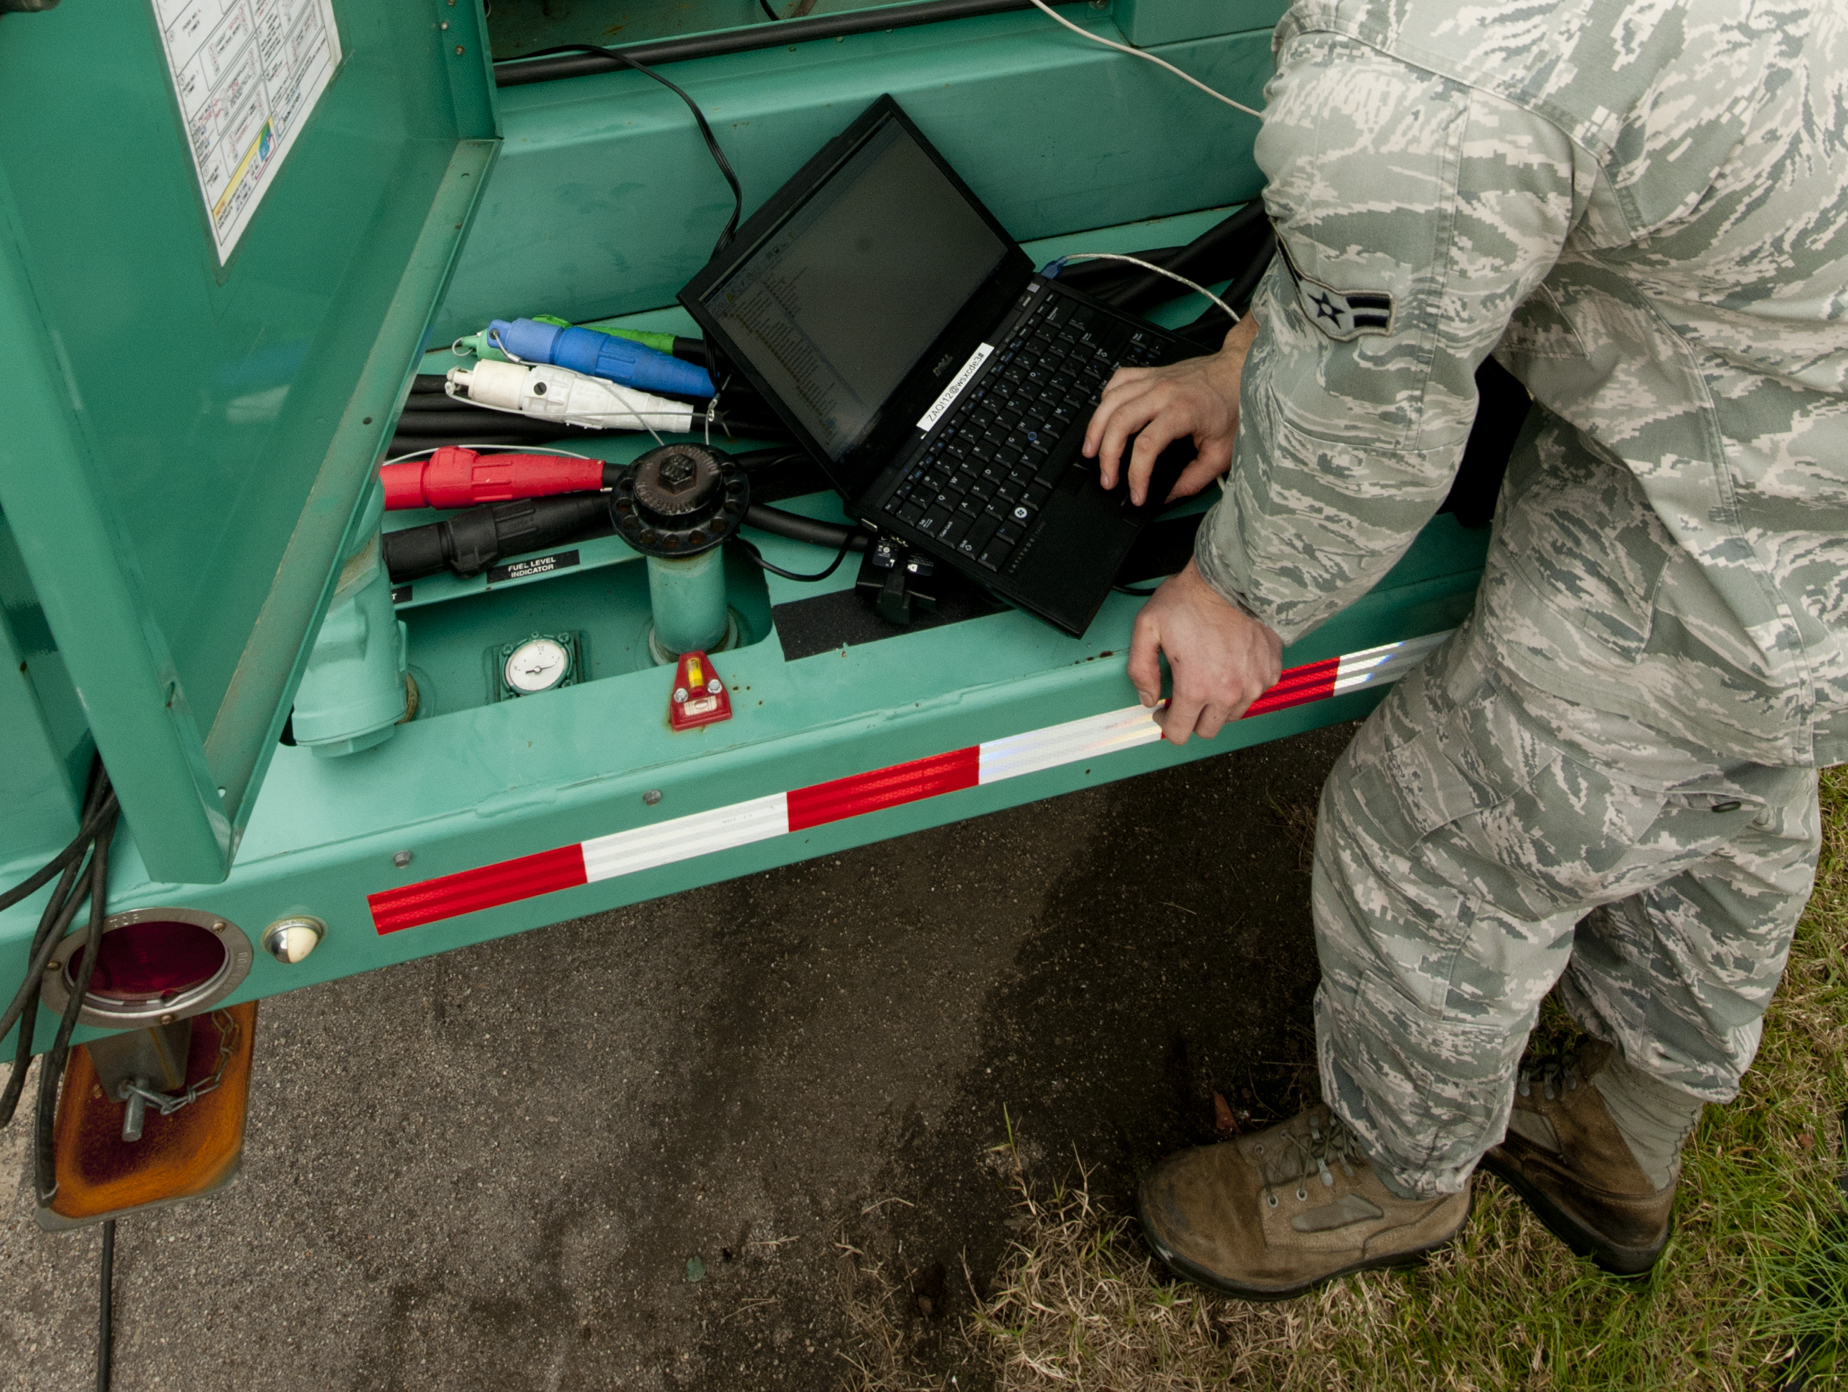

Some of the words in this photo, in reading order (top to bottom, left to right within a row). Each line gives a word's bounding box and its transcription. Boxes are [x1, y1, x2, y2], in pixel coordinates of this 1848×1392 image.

[925, 351, 987, 422] ZAQ!12@wsxcde3#
[508, 563, 530, 572] FUEL
[530, 557, 556, 568] LEVEL
[511, 564, 554, 578] INDICATOR
